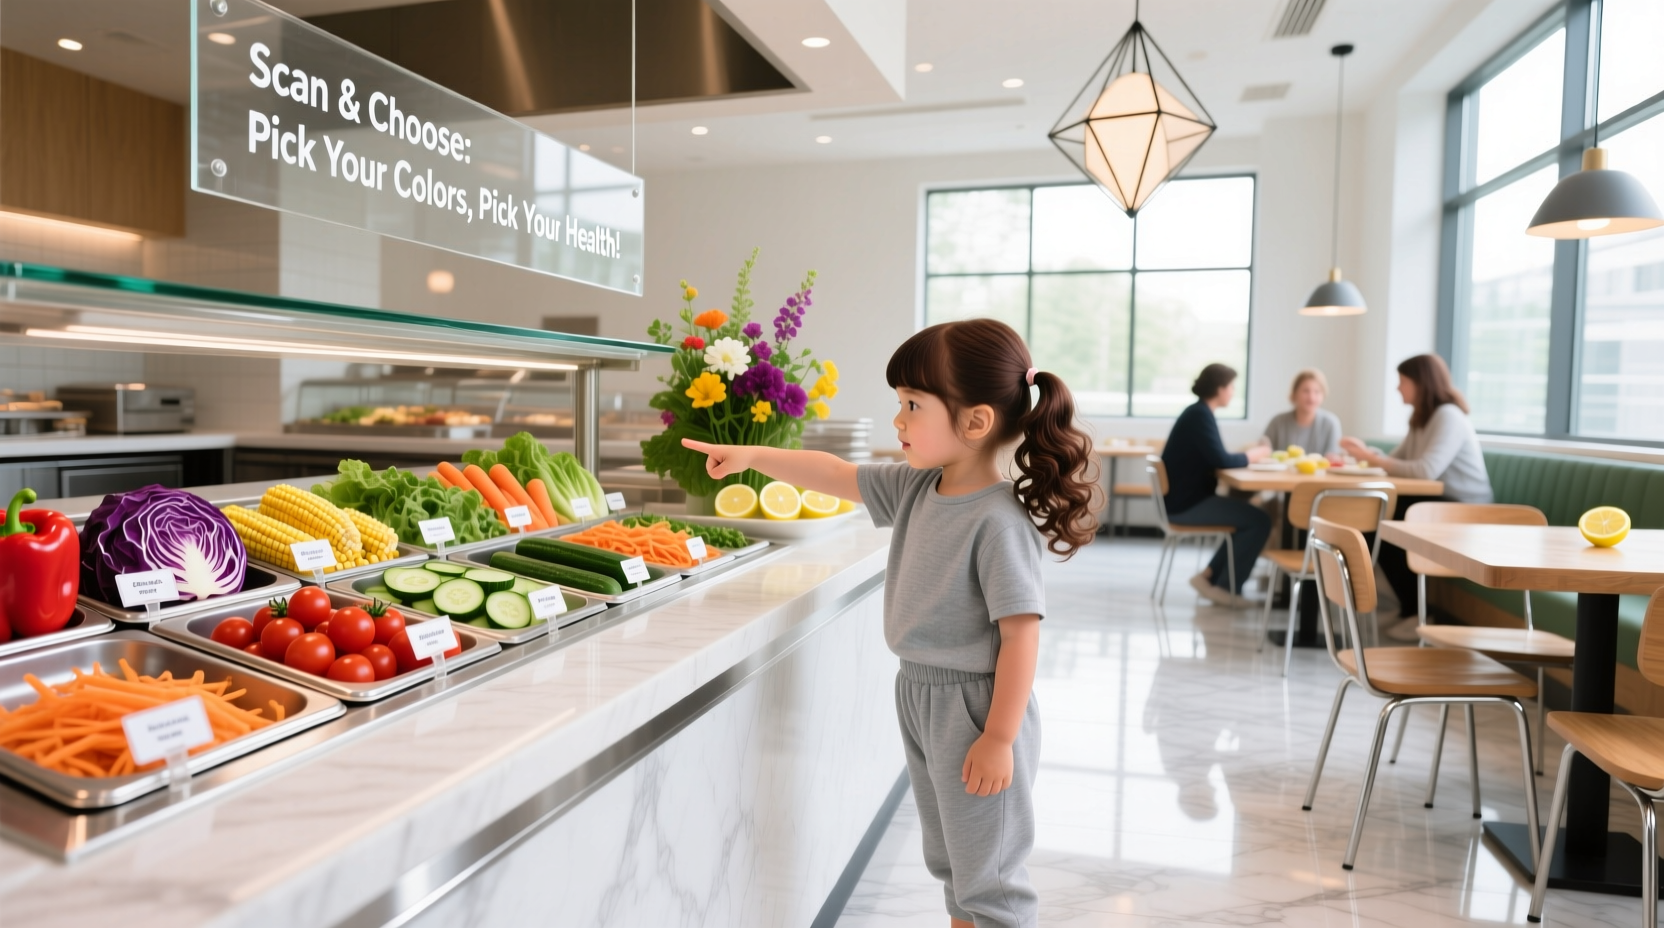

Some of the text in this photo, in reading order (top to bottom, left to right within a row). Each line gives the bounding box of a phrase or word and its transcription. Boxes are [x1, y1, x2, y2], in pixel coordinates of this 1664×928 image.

[249, 42, 472, 164] Scan & Choose:
[248, 110, 621, 259] Pick Your Colors, Pick Your Health!
